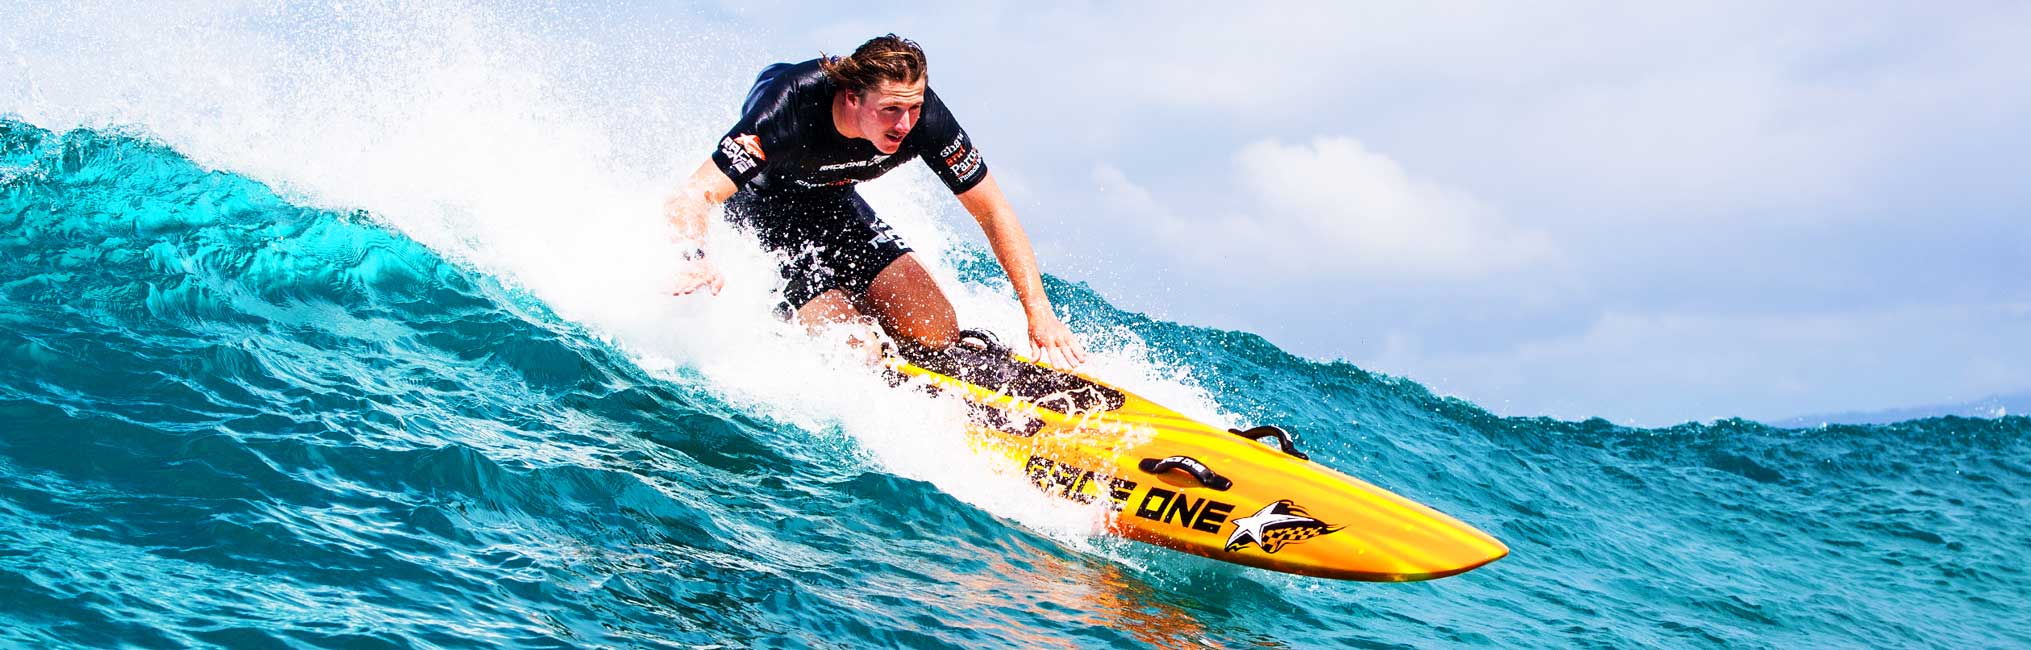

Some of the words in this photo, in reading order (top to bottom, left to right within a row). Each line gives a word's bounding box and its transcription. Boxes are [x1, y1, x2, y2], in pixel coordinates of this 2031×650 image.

[720, 136, 757, 168] RACE
[721, 148, 750, 174] ONE
[945, 145, 966, 167] and
[1024, 455, 1138, 513] RACE
[1136, 486, 1236, 534] ONE
